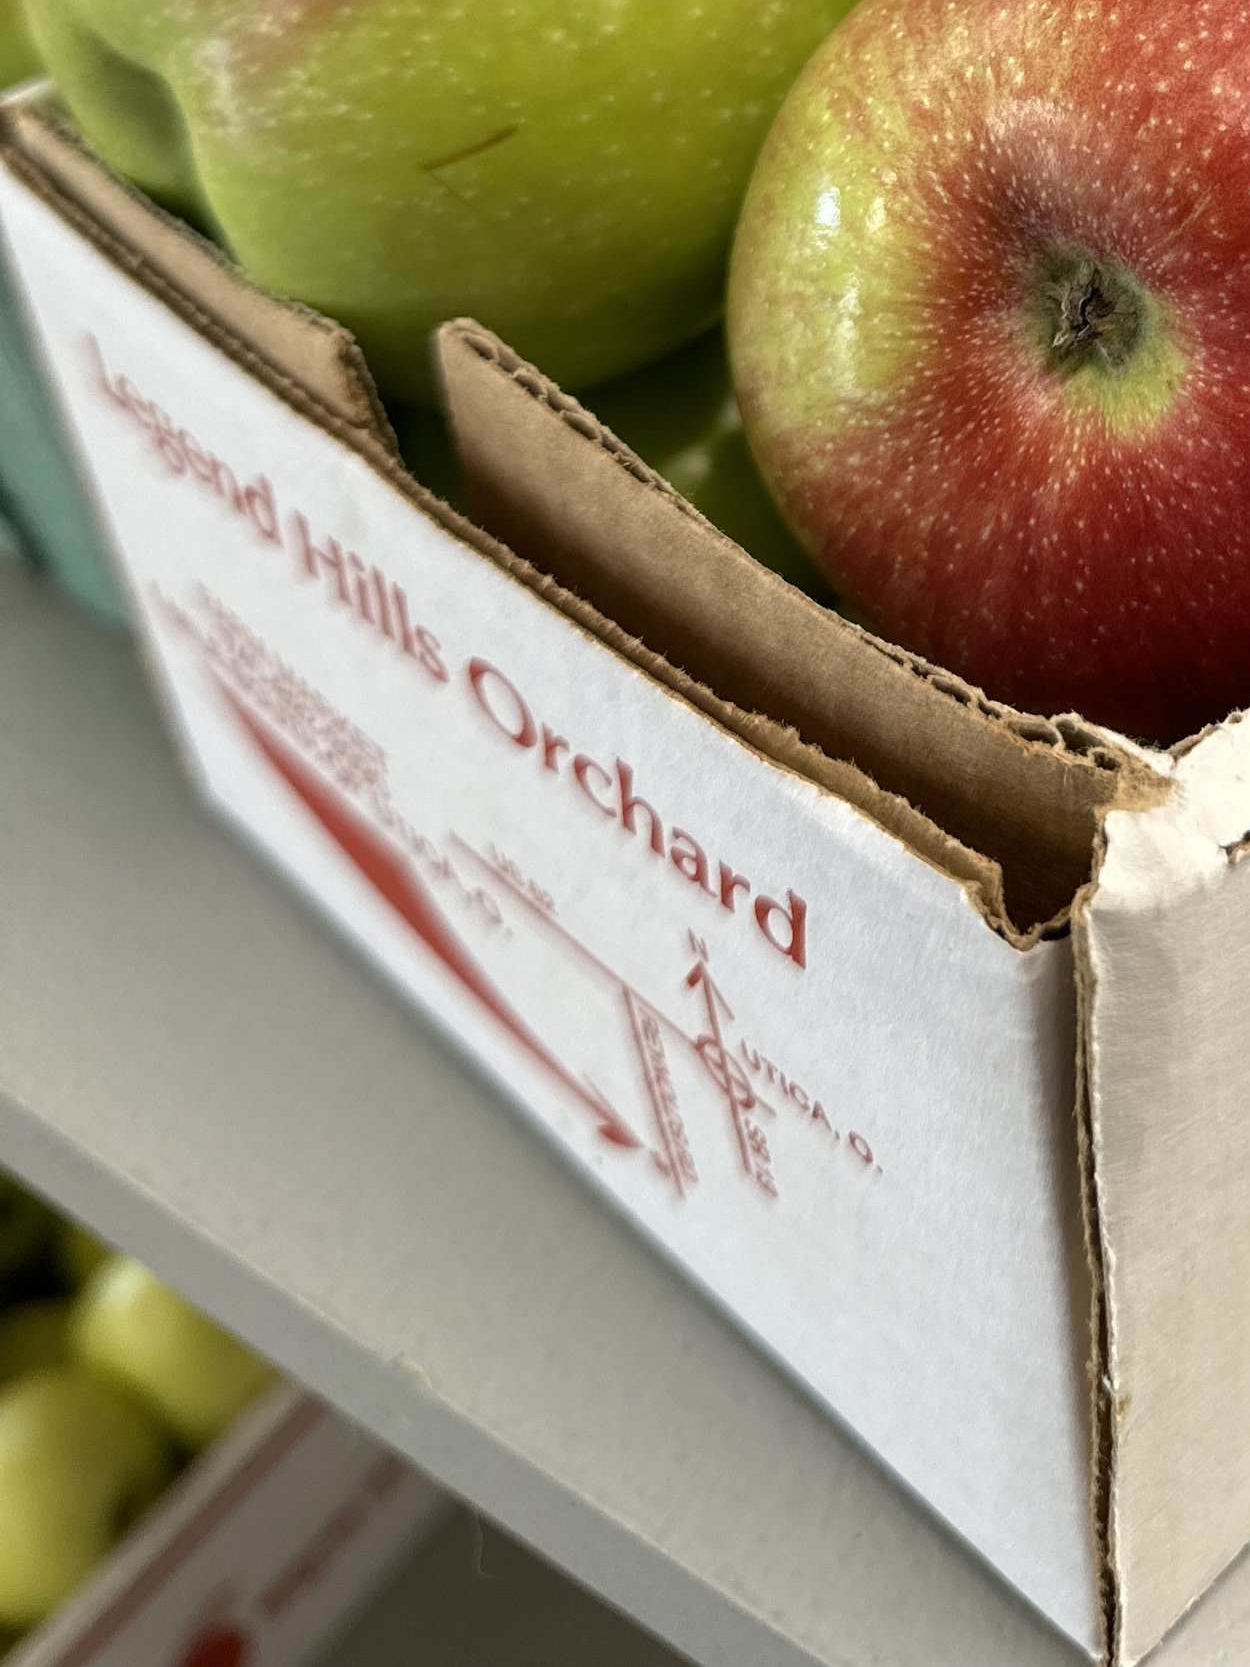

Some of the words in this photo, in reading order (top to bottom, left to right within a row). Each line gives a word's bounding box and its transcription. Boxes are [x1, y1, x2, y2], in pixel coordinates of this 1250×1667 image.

[82, 329, 283, 549] Legend
[291, 507, 450, 683] Hills
[468, 656, 808, 970] Orchard
[687, 926, 709, 963] N
[740, 1038, 841, 1141] UTICA,
